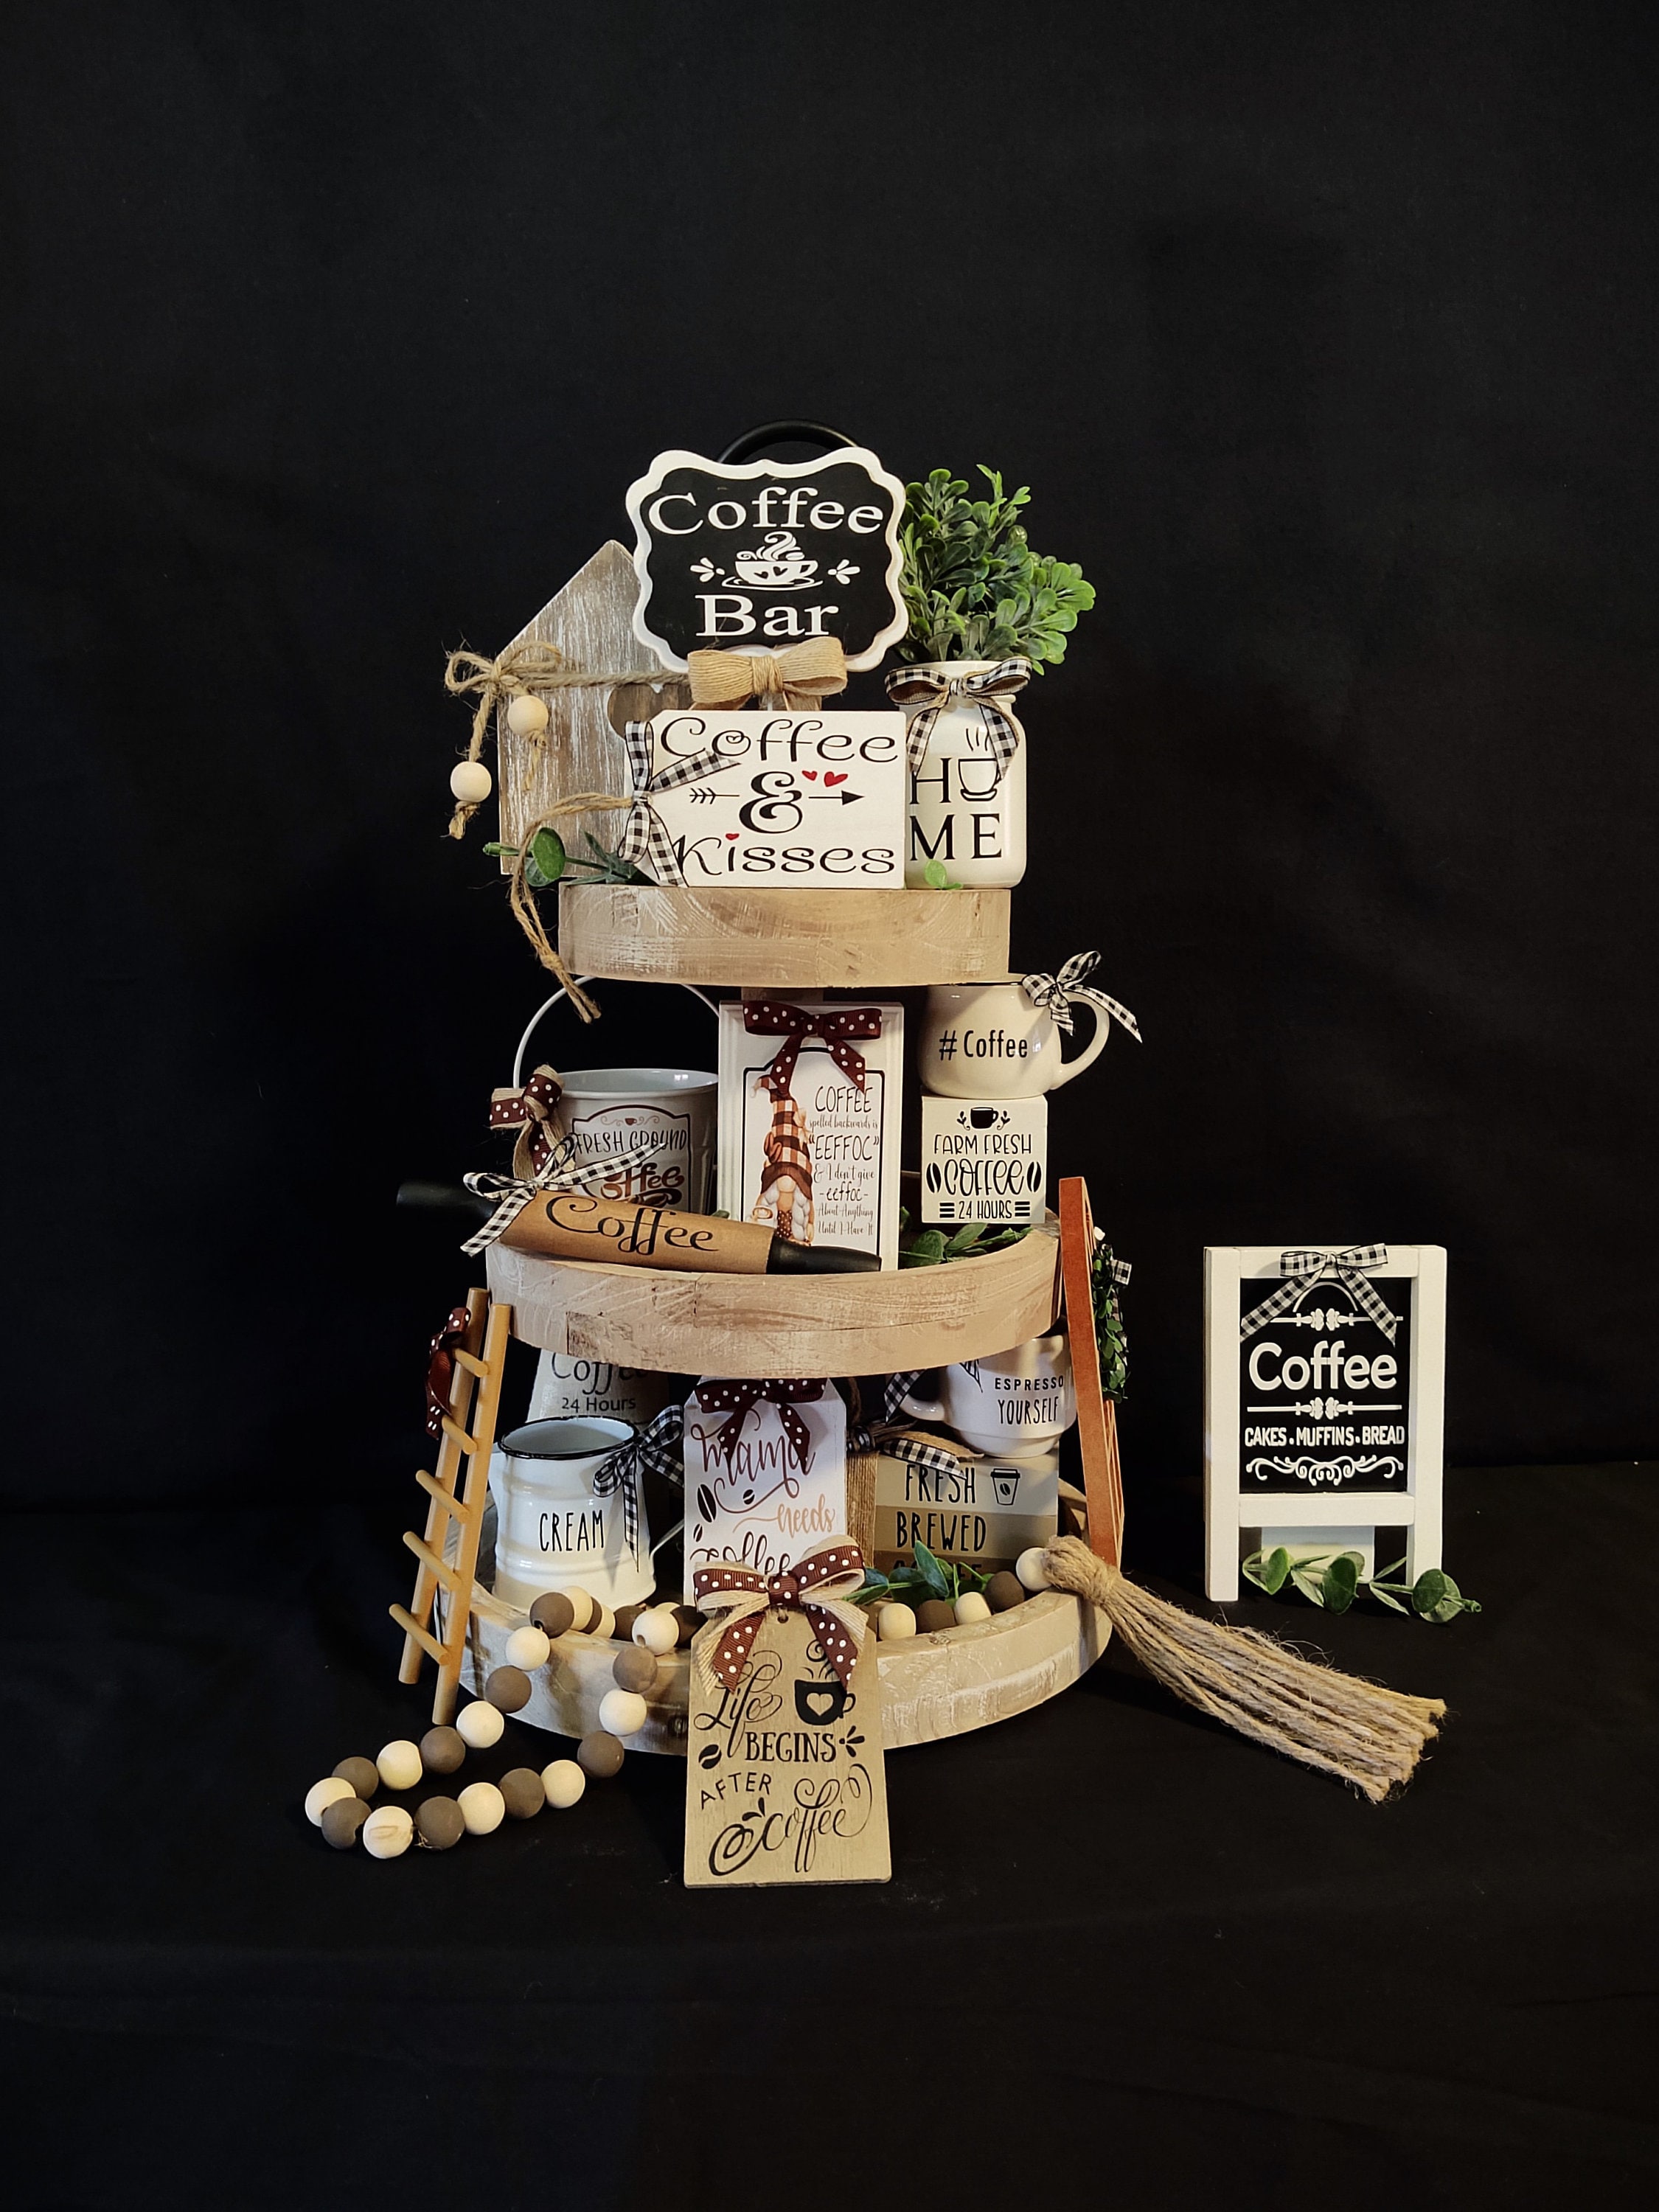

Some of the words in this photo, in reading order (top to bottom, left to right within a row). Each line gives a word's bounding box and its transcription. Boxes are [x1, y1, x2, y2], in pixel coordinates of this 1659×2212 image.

[648, 486, 884, 535] Coffee
[695, 594, 840, 638] Bar
[660, 716, 899, 763] Coffee
[738, 771, 804, 835] &
[672, 832, 896, 877] Kisses
[815, 1085, 873, 1113] COFFEE
[834, 1114, 871, 1130] backwards
[576, 1130, 624, 1155] FRESH
[630, 1129, 687, 1152] GROUND
[933, 1134, 978, 1155] FARM
[984, 1133, 1032, 1155] FRESH
[858, 1169, 874, 1187] give
[545, 1194, 720, 1256] Coffee
[959, 1200, 972, 1219] 24
[977, 1200, 1012, 1220] HOURS
[995, 1375, 1064, 1391] ESPRESSO
[1248, 1340, 1398, 1391] Coffee
[561, 1397, 580, 1413] 24
[585, 1397, 636, 1412] Hours
[998, 1396, 1060, 1425] YOURSELF
[1363, 1425, 1405, 1445] BREAD
[905, 1464, 975, 1505] FRESH
[539, 1509, 605, 1552] CREAM
[772, 1493, 836, 1539] needs
[896, 1511, 987, 1553] BREWED
[693, 1650, 783, 1759] Life
[744, 1731, 837, 1763] BEGINS
[699, 1772, 772, 1810] AFTER
